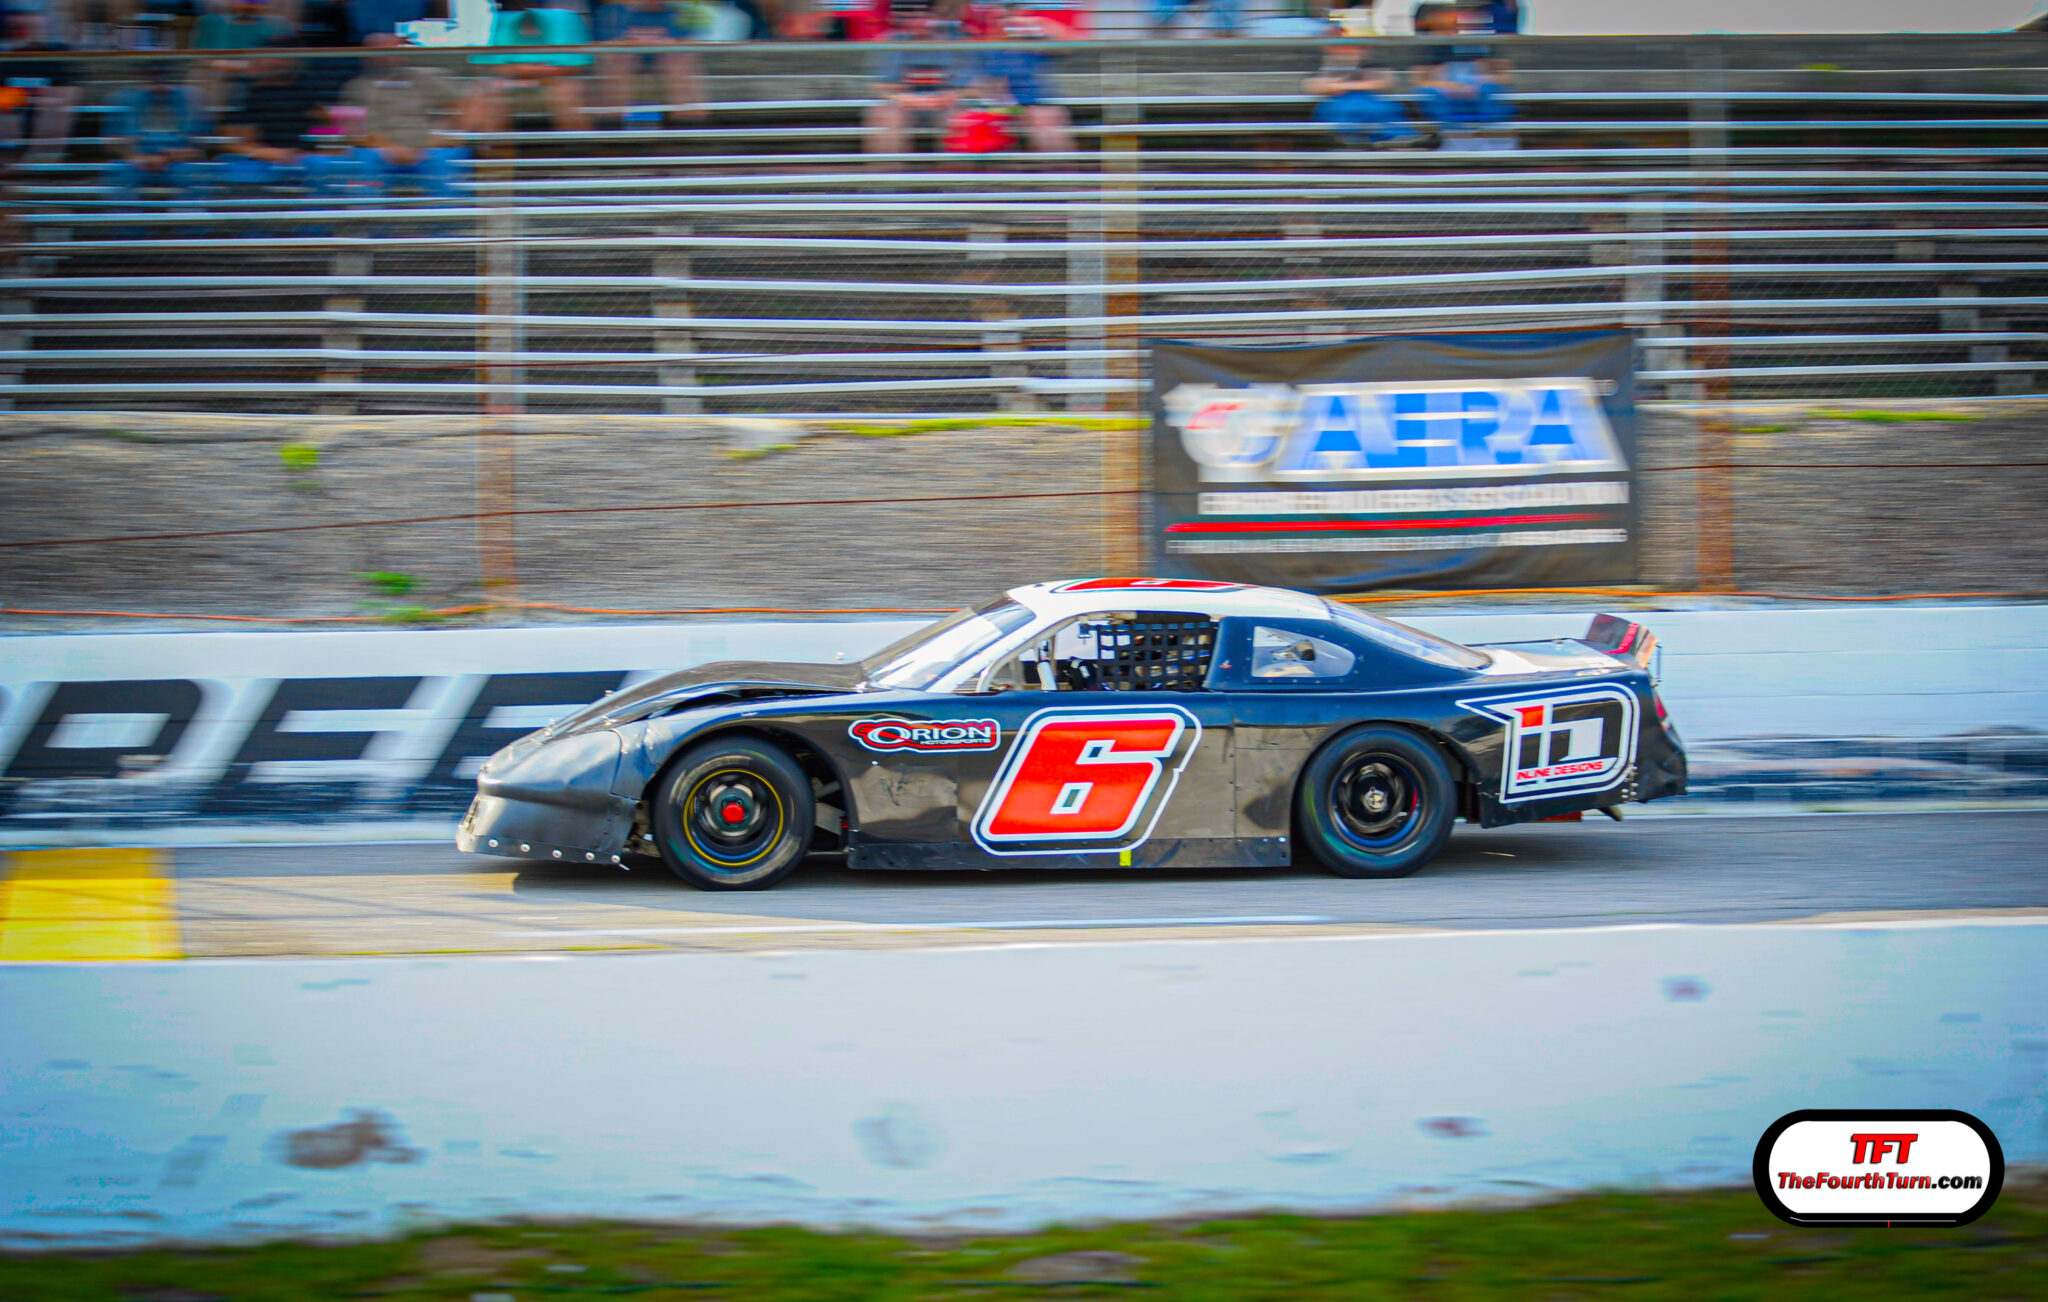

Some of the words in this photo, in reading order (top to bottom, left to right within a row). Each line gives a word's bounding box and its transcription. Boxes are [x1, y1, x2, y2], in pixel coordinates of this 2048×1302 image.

[1284, 388, 1612, 472] AERA
[0, 671, 630, 815] PEE
[867, 726, 992, 744] ORION
[1516, 768, 1550, 781] INLINE
[1553, 761, 1604, 776] DESIGNS
[977, 710, 1188, 846] 6
